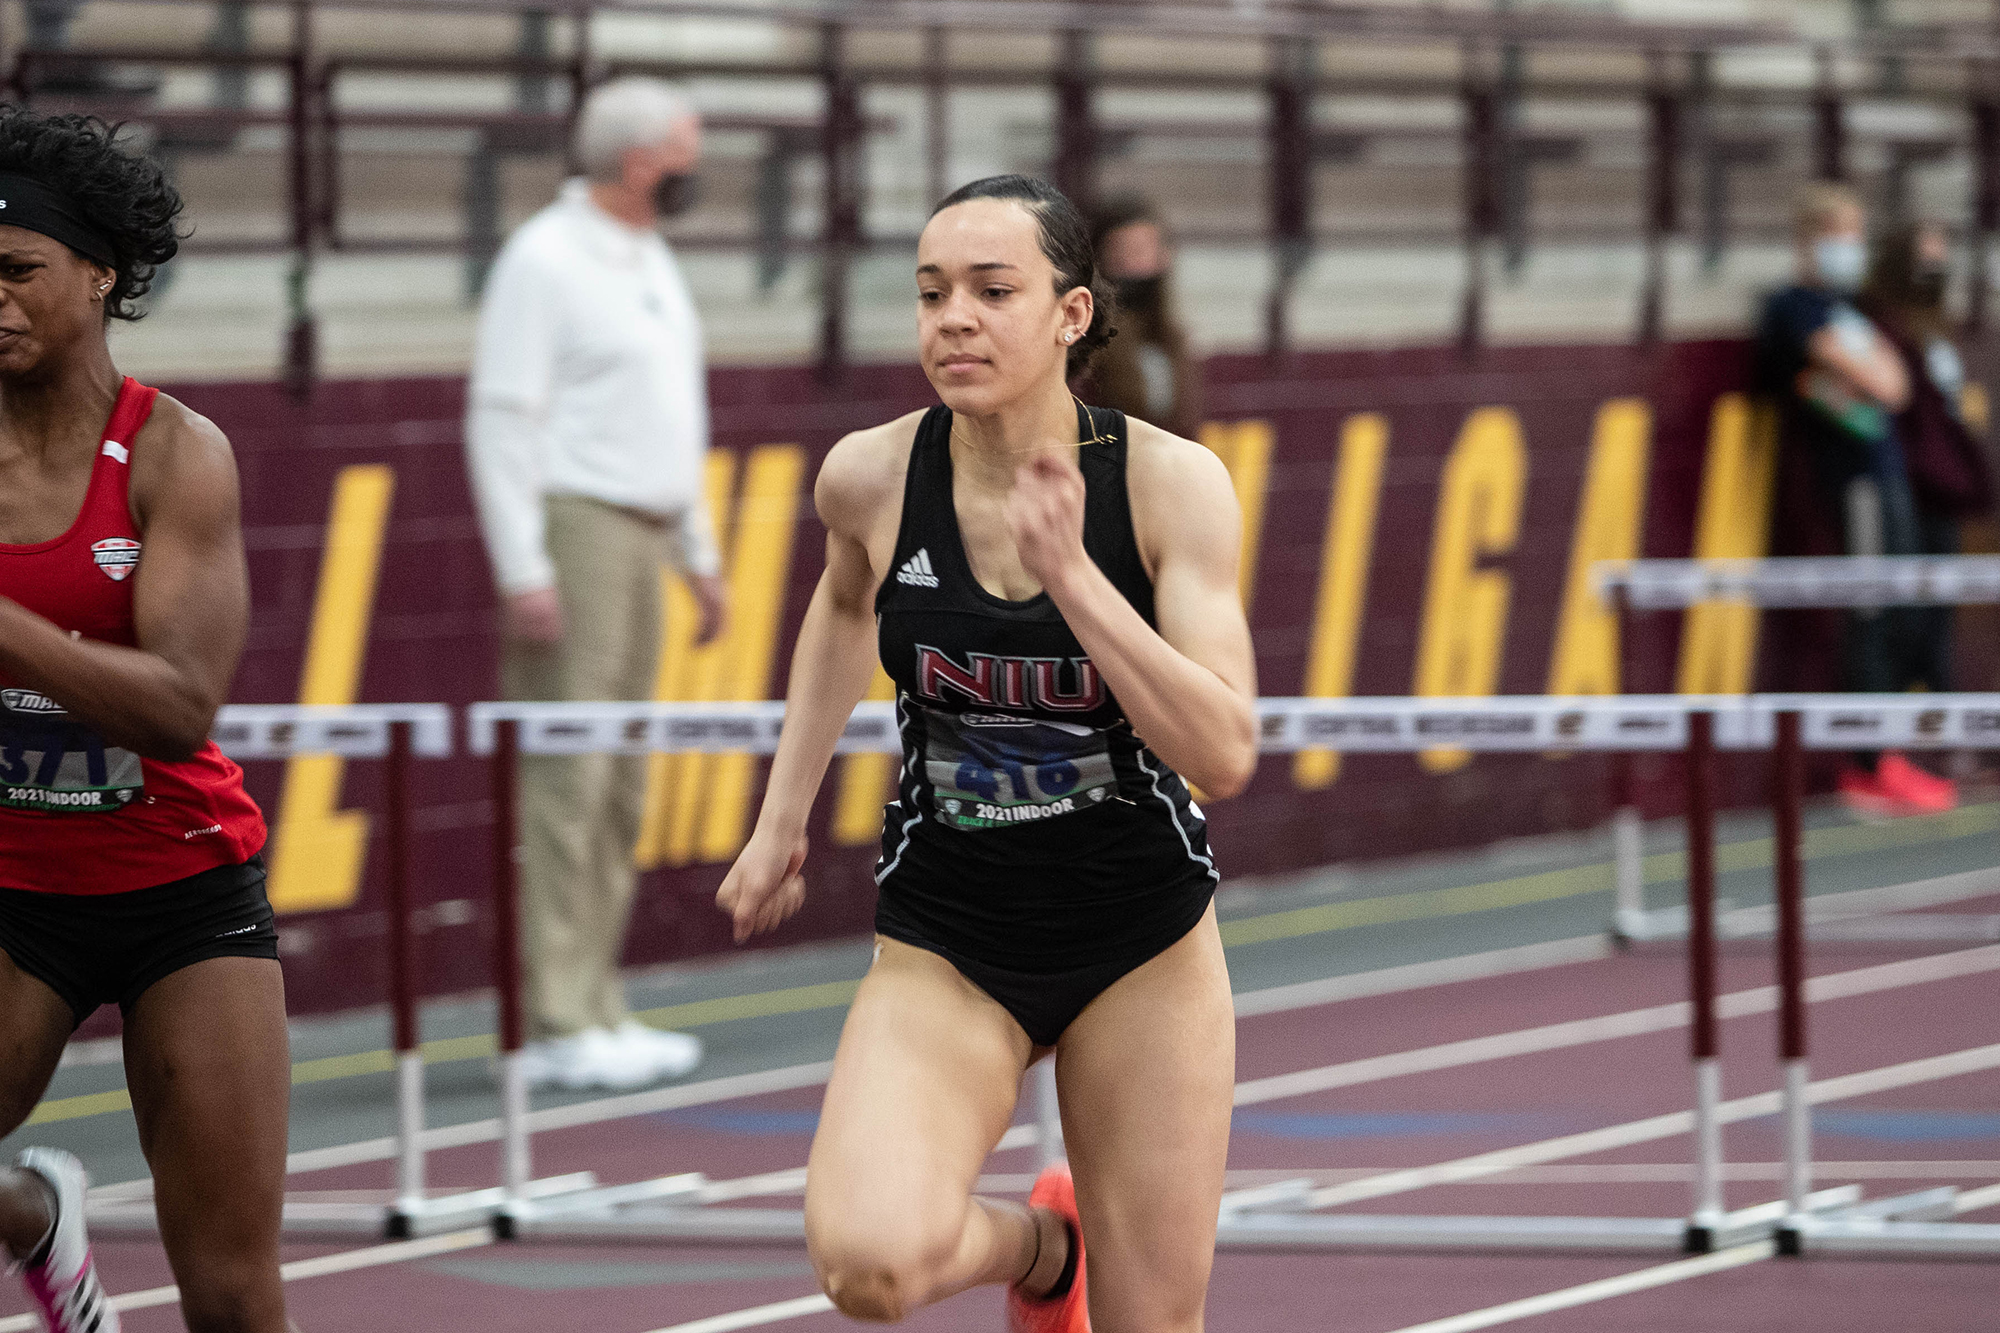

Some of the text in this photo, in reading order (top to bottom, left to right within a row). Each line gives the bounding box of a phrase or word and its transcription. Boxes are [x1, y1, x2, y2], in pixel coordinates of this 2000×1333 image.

[896, 570, 940, 588] adidas
[914, 643, 1106, 712] NIU
[975, 798, 1075, 821] 2021 INDOOR
